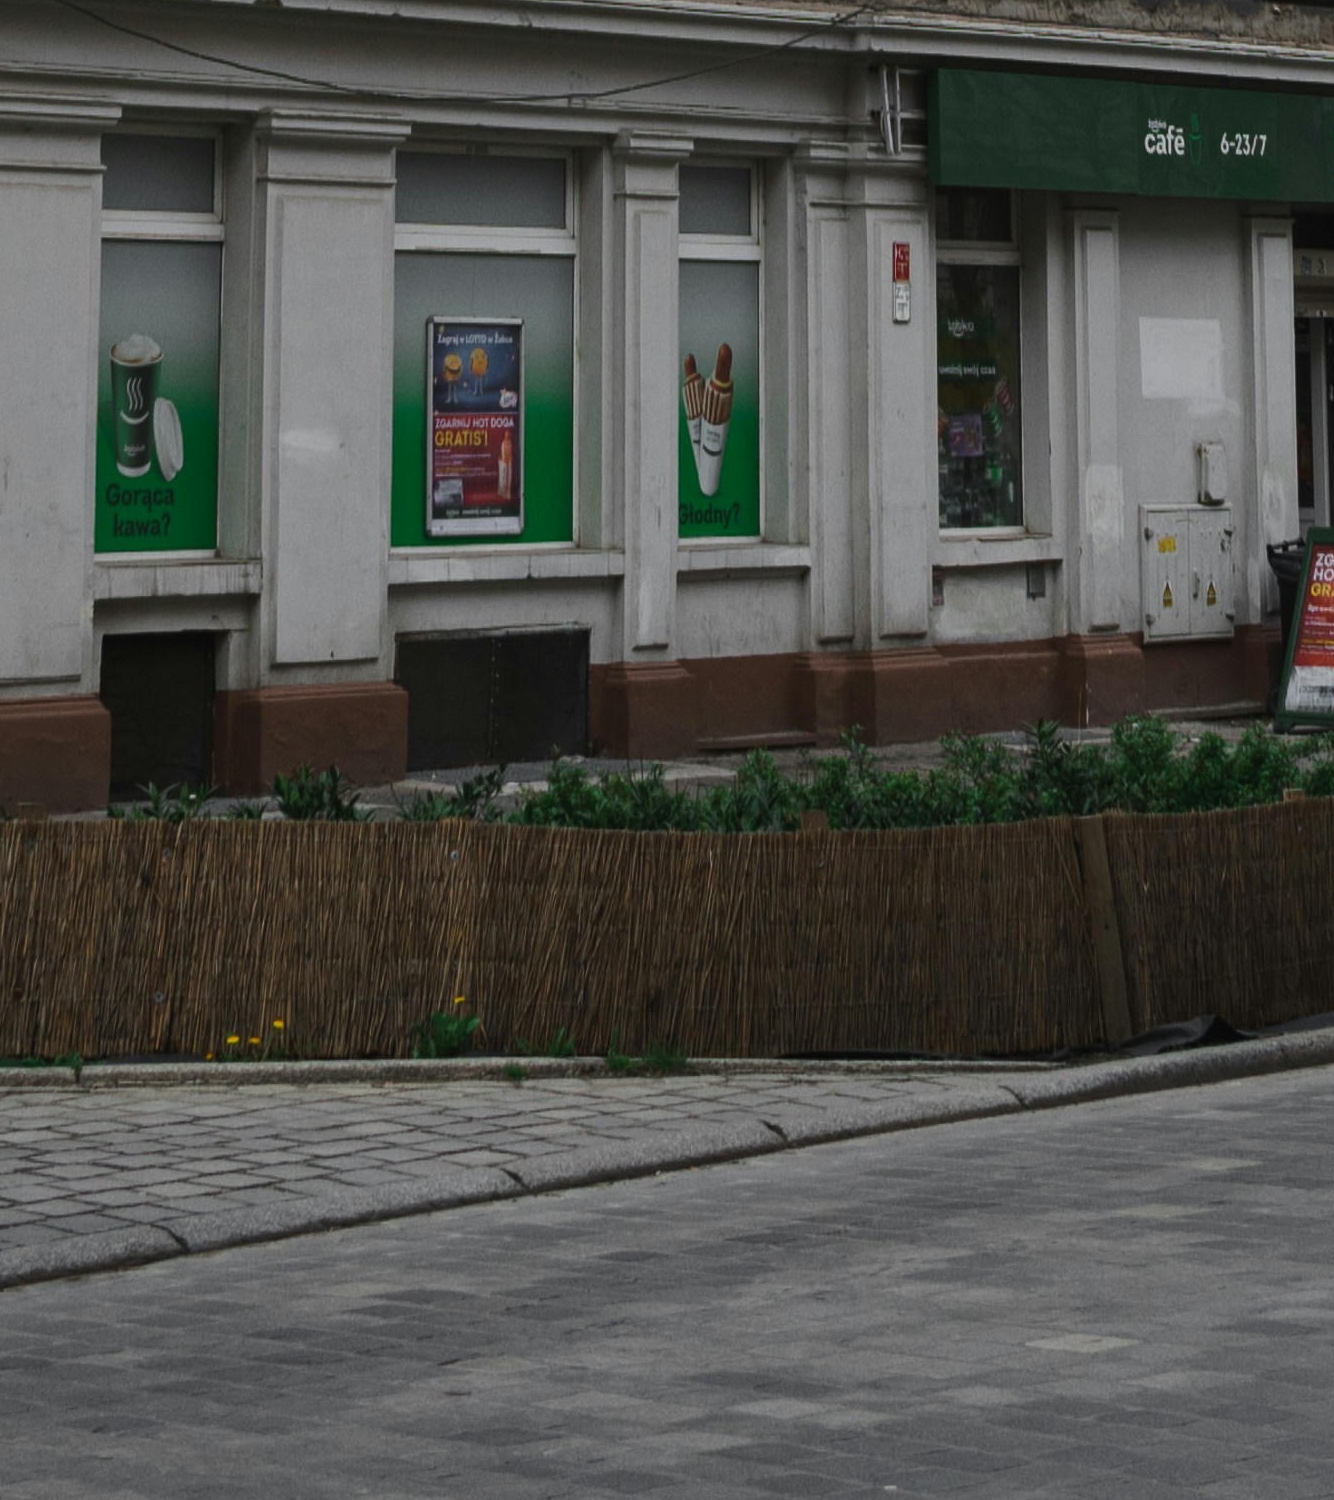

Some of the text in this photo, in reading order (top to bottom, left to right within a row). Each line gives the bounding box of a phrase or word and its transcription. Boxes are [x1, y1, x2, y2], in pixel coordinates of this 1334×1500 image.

[1220, 132, 1267, 156] 6-23/7
[472, 418, 489, 428] HOT
[491, 417, 515, 428] DOGA
[106, 483, 174, 513] Gorąca
[113, 513, 171, 537] kawa?
